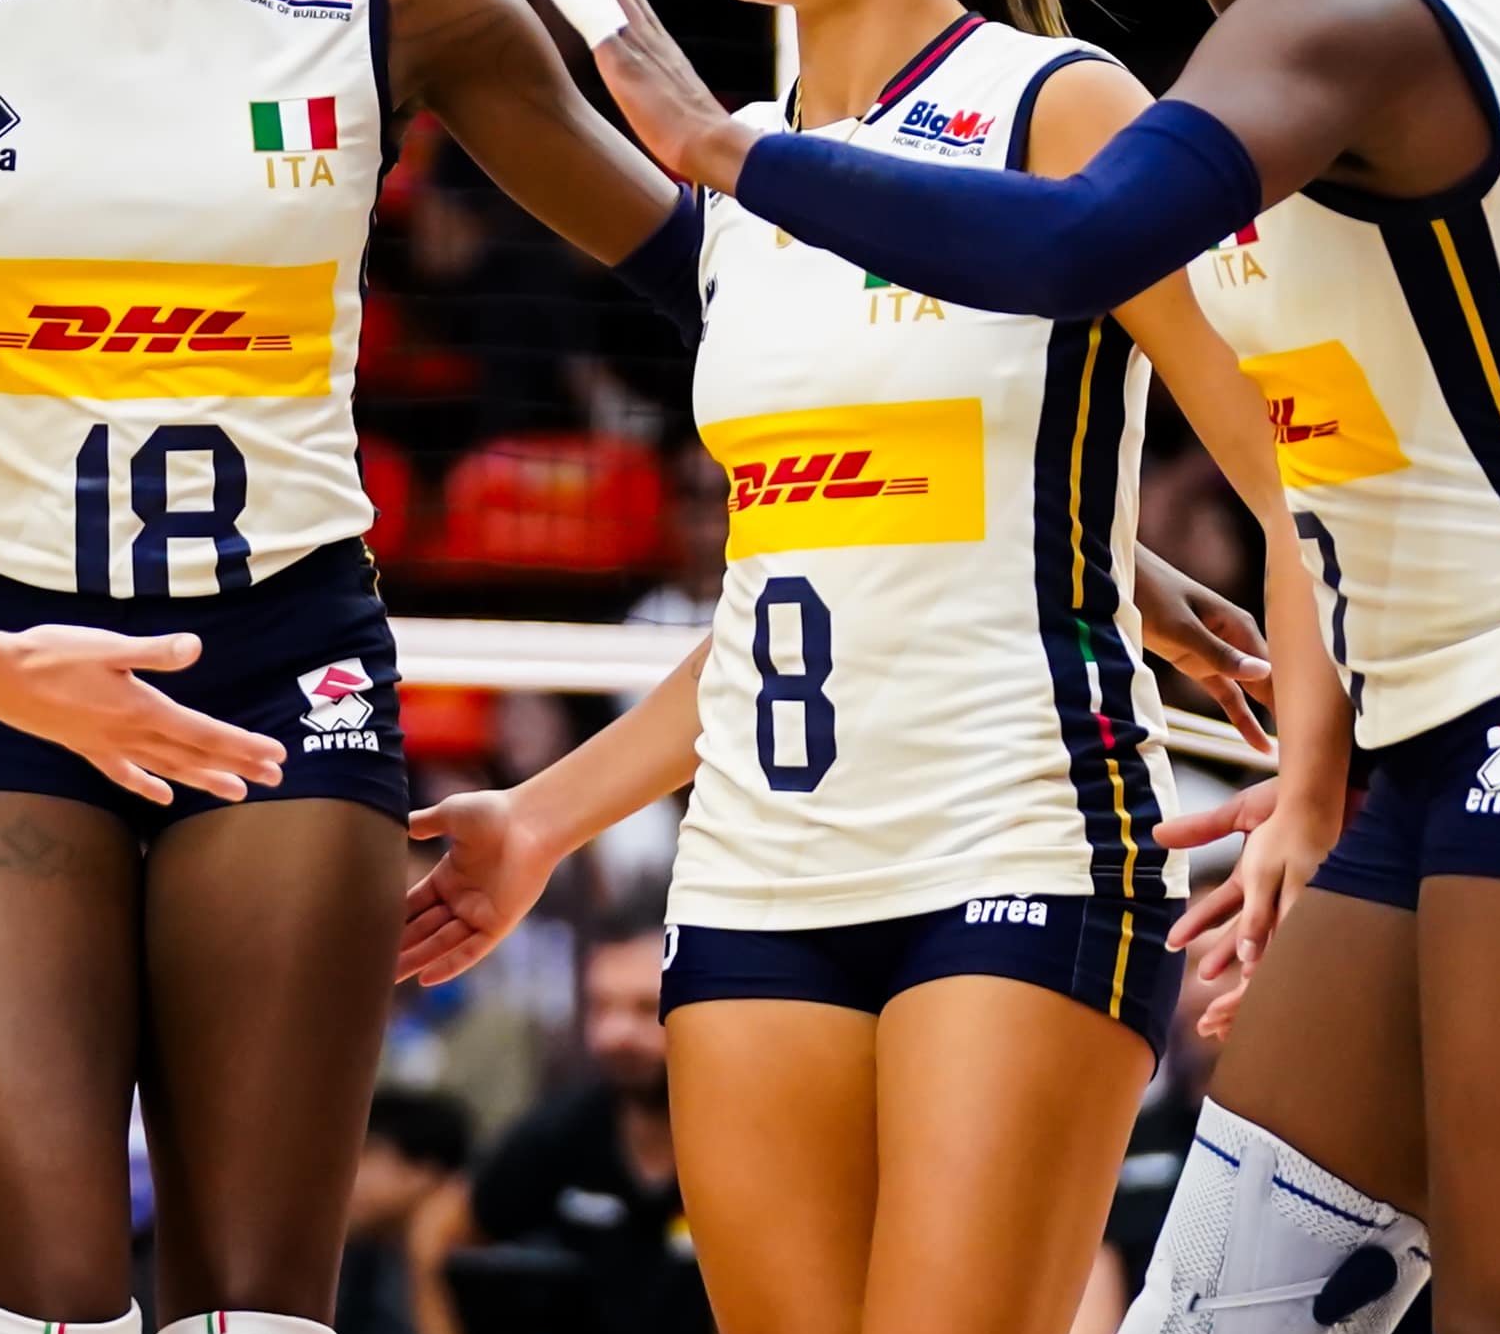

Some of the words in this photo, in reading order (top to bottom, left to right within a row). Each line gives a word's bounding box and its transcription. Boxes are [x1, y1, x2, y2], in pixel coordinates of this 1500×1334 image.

[277, 3, 291, 15] OF
[293, 9, 352, 23] BUILDERS
[266, 155, 336, 189] ITA
[1213, 249, 1268, 290] ITA
[27, 305, 254, 354] DHL
[869, 291, 945, 324] ITA
[727, 450, 887, 512] DHL
[75, 424, 253, 599] 18
[752, 576, 837, 793] 8
